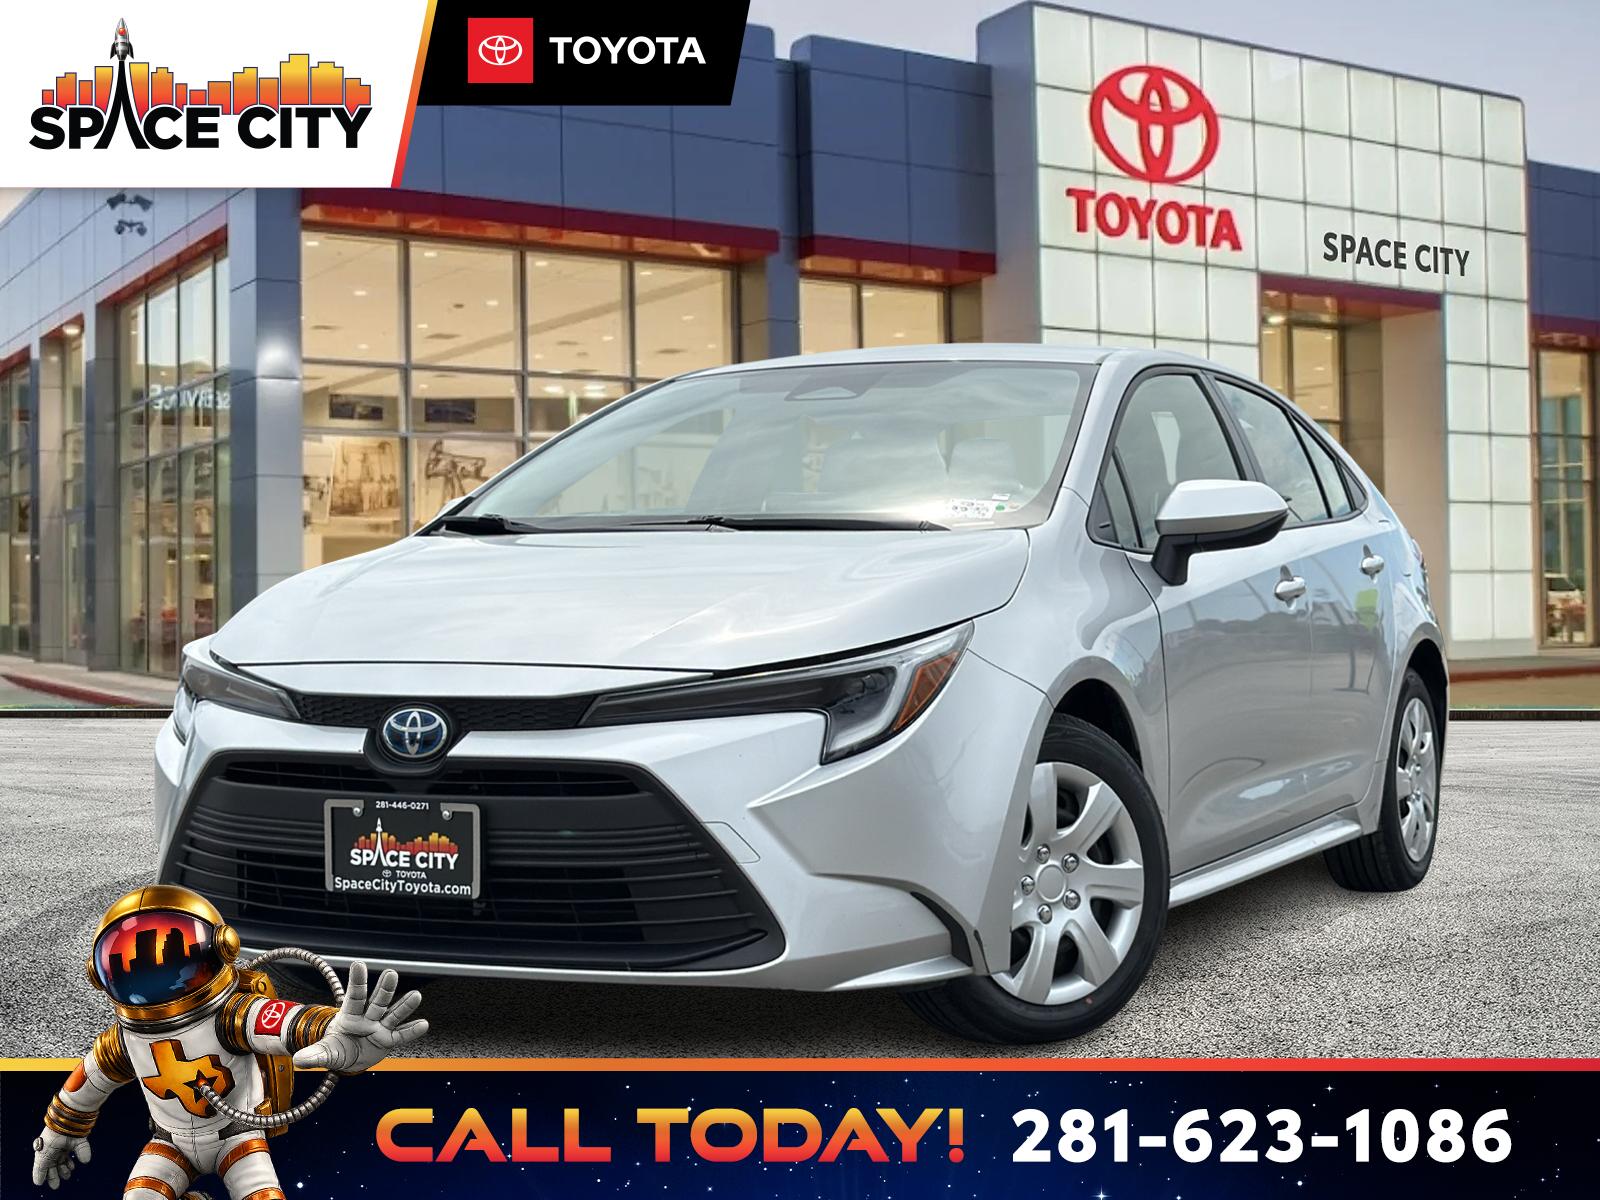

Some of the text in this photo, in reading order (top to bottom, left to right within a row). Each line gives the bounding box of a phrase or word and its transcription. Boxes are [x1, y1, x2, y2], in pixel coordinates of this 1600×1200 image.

[1066, 187, 1243, 252] TOYOTA
[1323, 232, 1471, 277] SPACE CITY
[375, 800, 430, 811] 281-446-0271
[350, 848, 459, 870] SPACE CITY
[396, 870, 427, 879] TOYOTA
[334, 876, 472, 896] SpaceCityToyota.com
